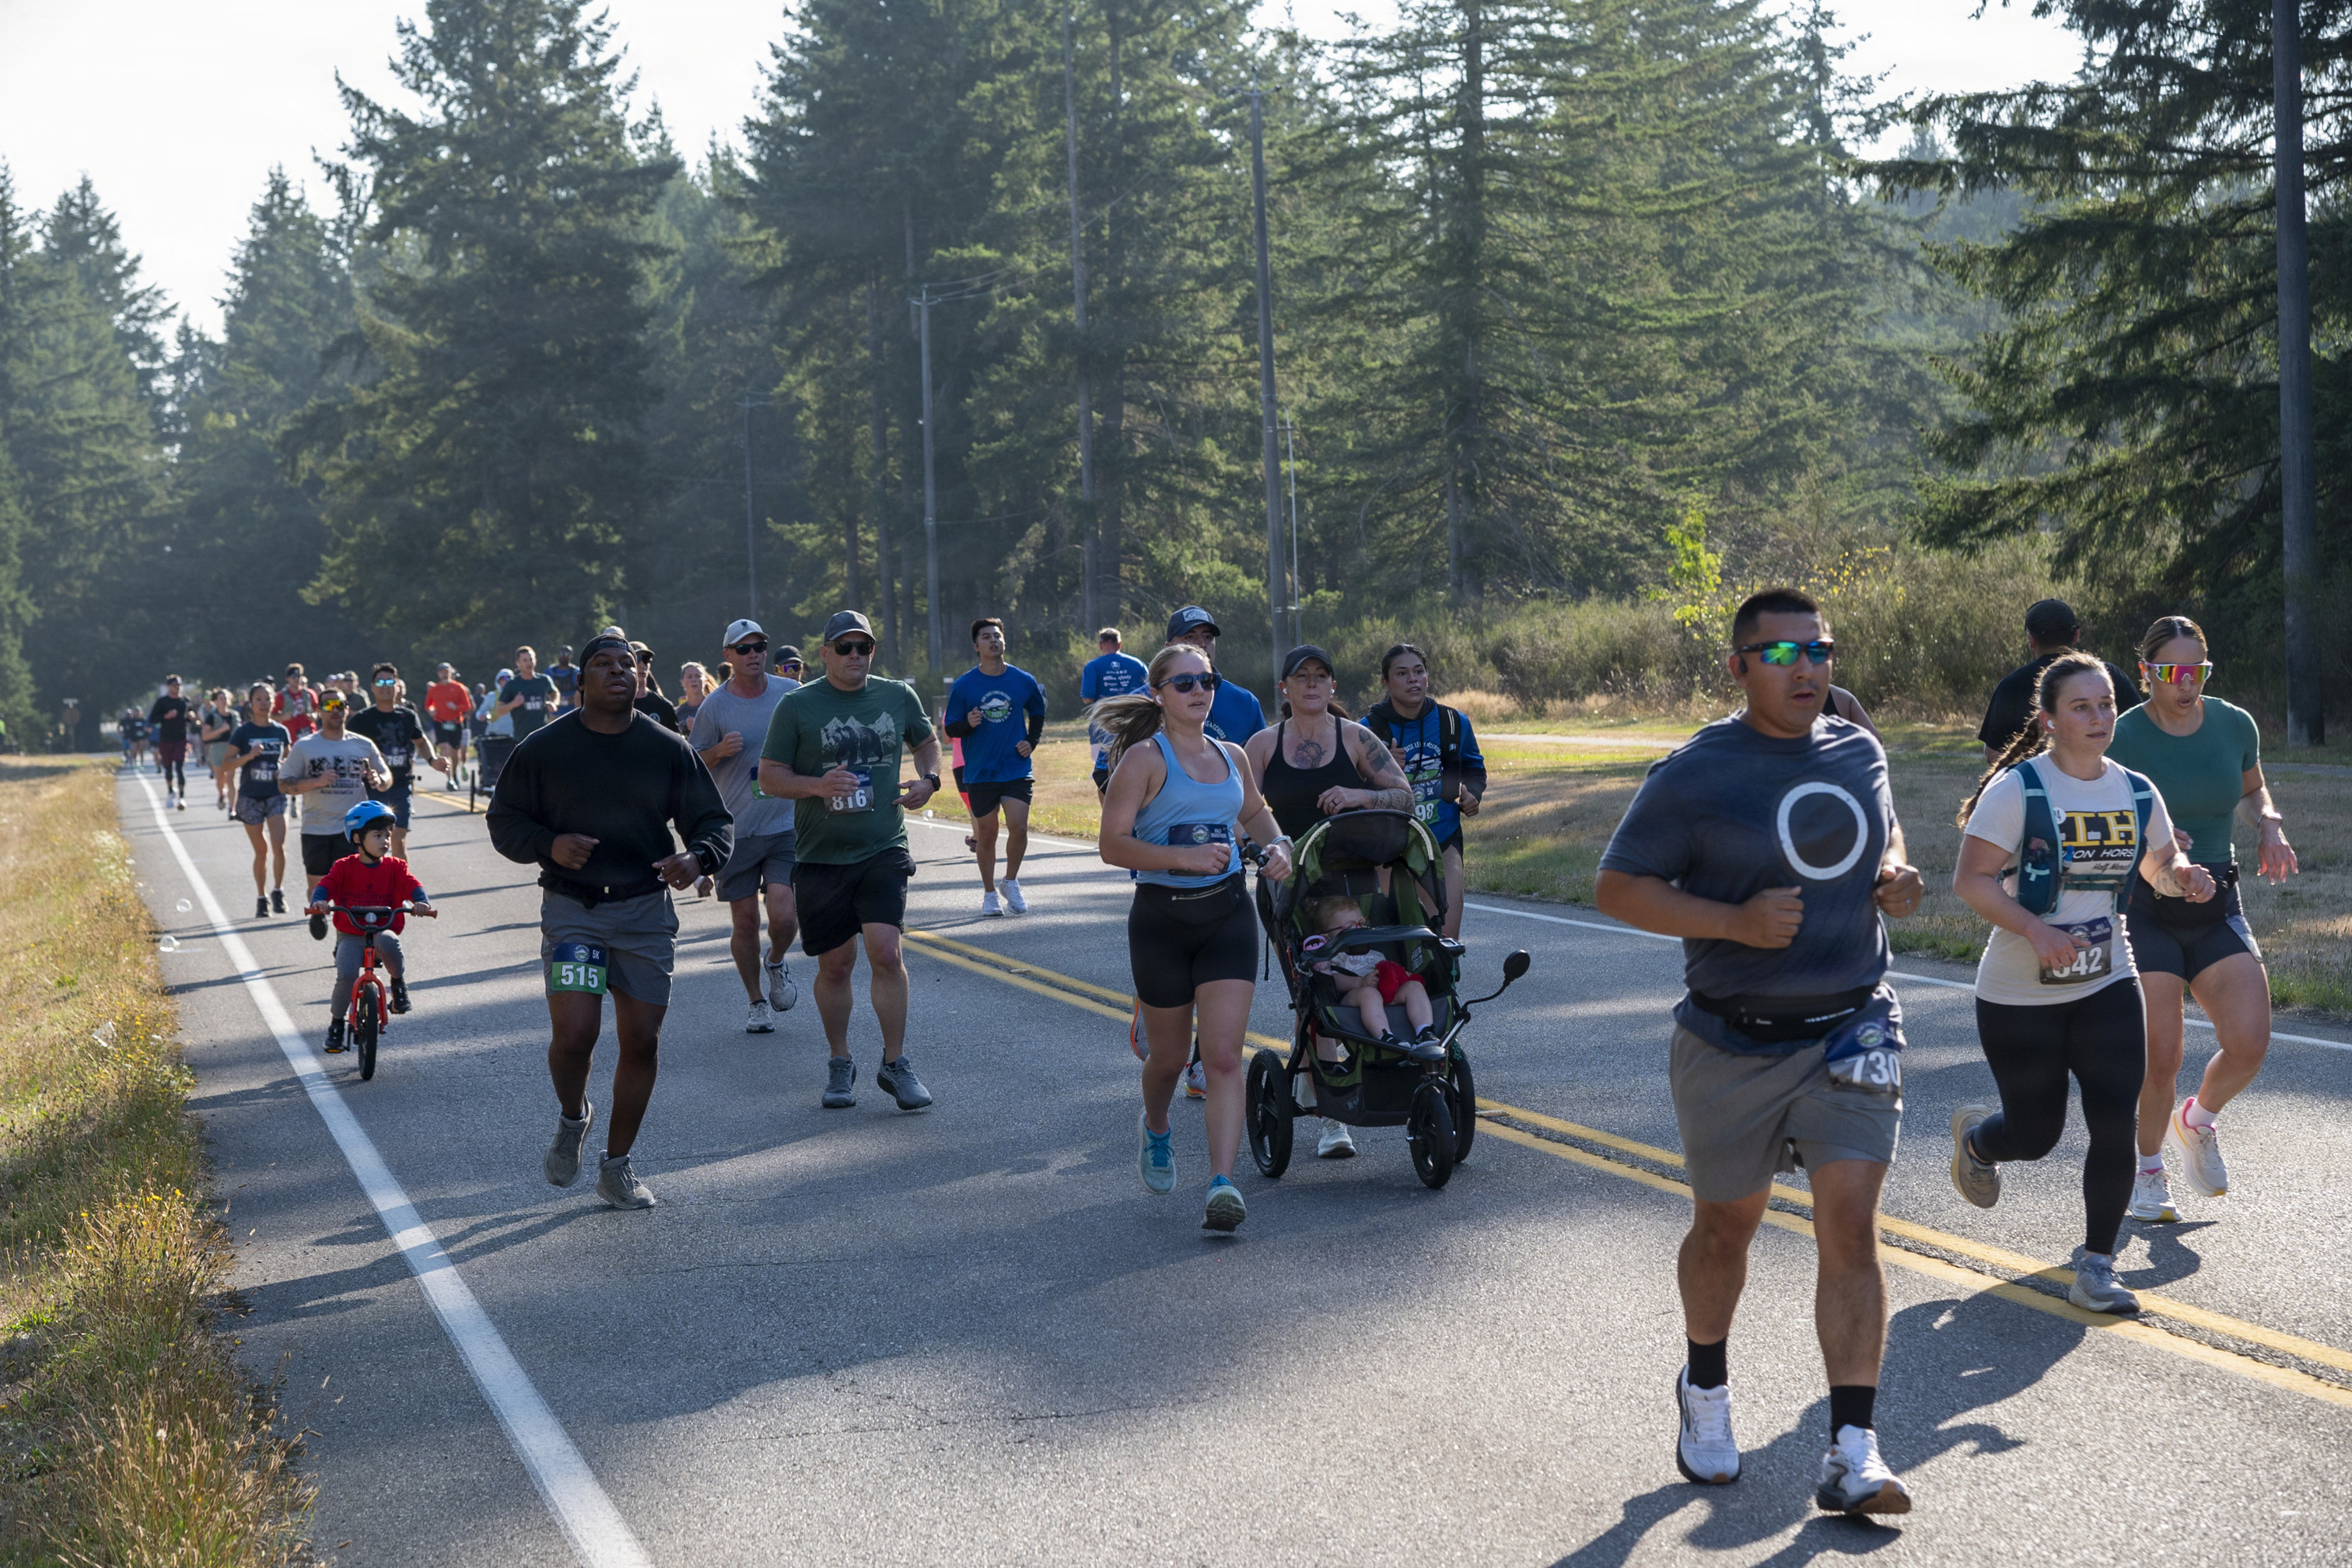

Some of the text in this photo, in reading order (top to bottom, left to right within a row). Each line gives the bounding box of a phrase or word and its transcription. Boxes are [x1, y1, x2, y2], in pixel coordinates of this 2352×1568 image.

[254, 769, 272, 781] 761
[1426, 787, 1434, 796] 5K
[831, 789, 867, 810] 816
[2100, 849, 2135, 857] HORS
[592, 950, 600, 960] 5K
[561, 964, 598, 989] 515
[1845, 1050, 1902, 1087] 730
